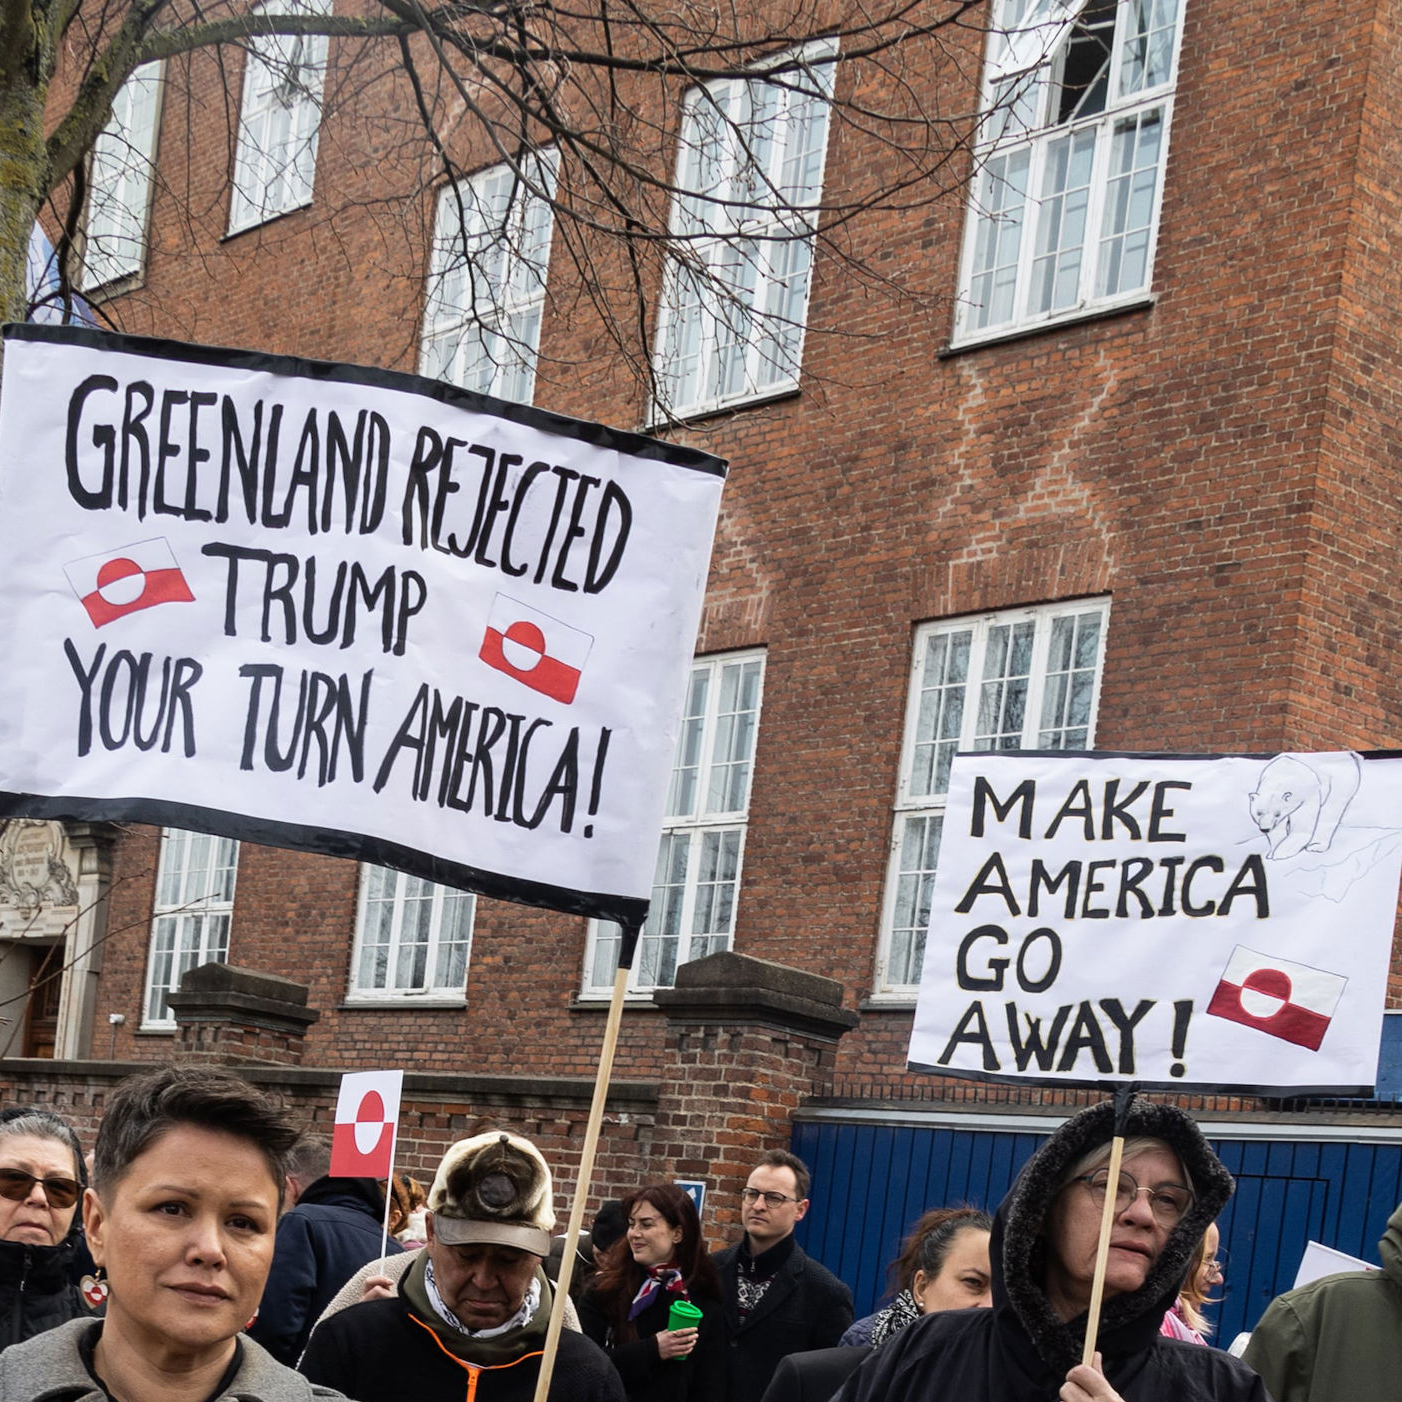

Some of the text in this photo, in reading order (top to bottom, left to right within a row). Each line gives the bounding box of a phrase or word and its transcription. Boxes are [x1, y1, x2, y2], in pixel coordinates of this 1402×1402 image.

[65, 374, 633, 595] GREENLAND REJECTED
[201, 541, 428, 657] TRUMP
[64, 637, 613, 840] YOUR TURN AMERICA!
[969, 775, 1193, 843] MAKE
[954, 850, 1270, 920] AMERICA
[956, 923, 1063, 994] GO
[935, 997, 1195, 1079] AWAY!
